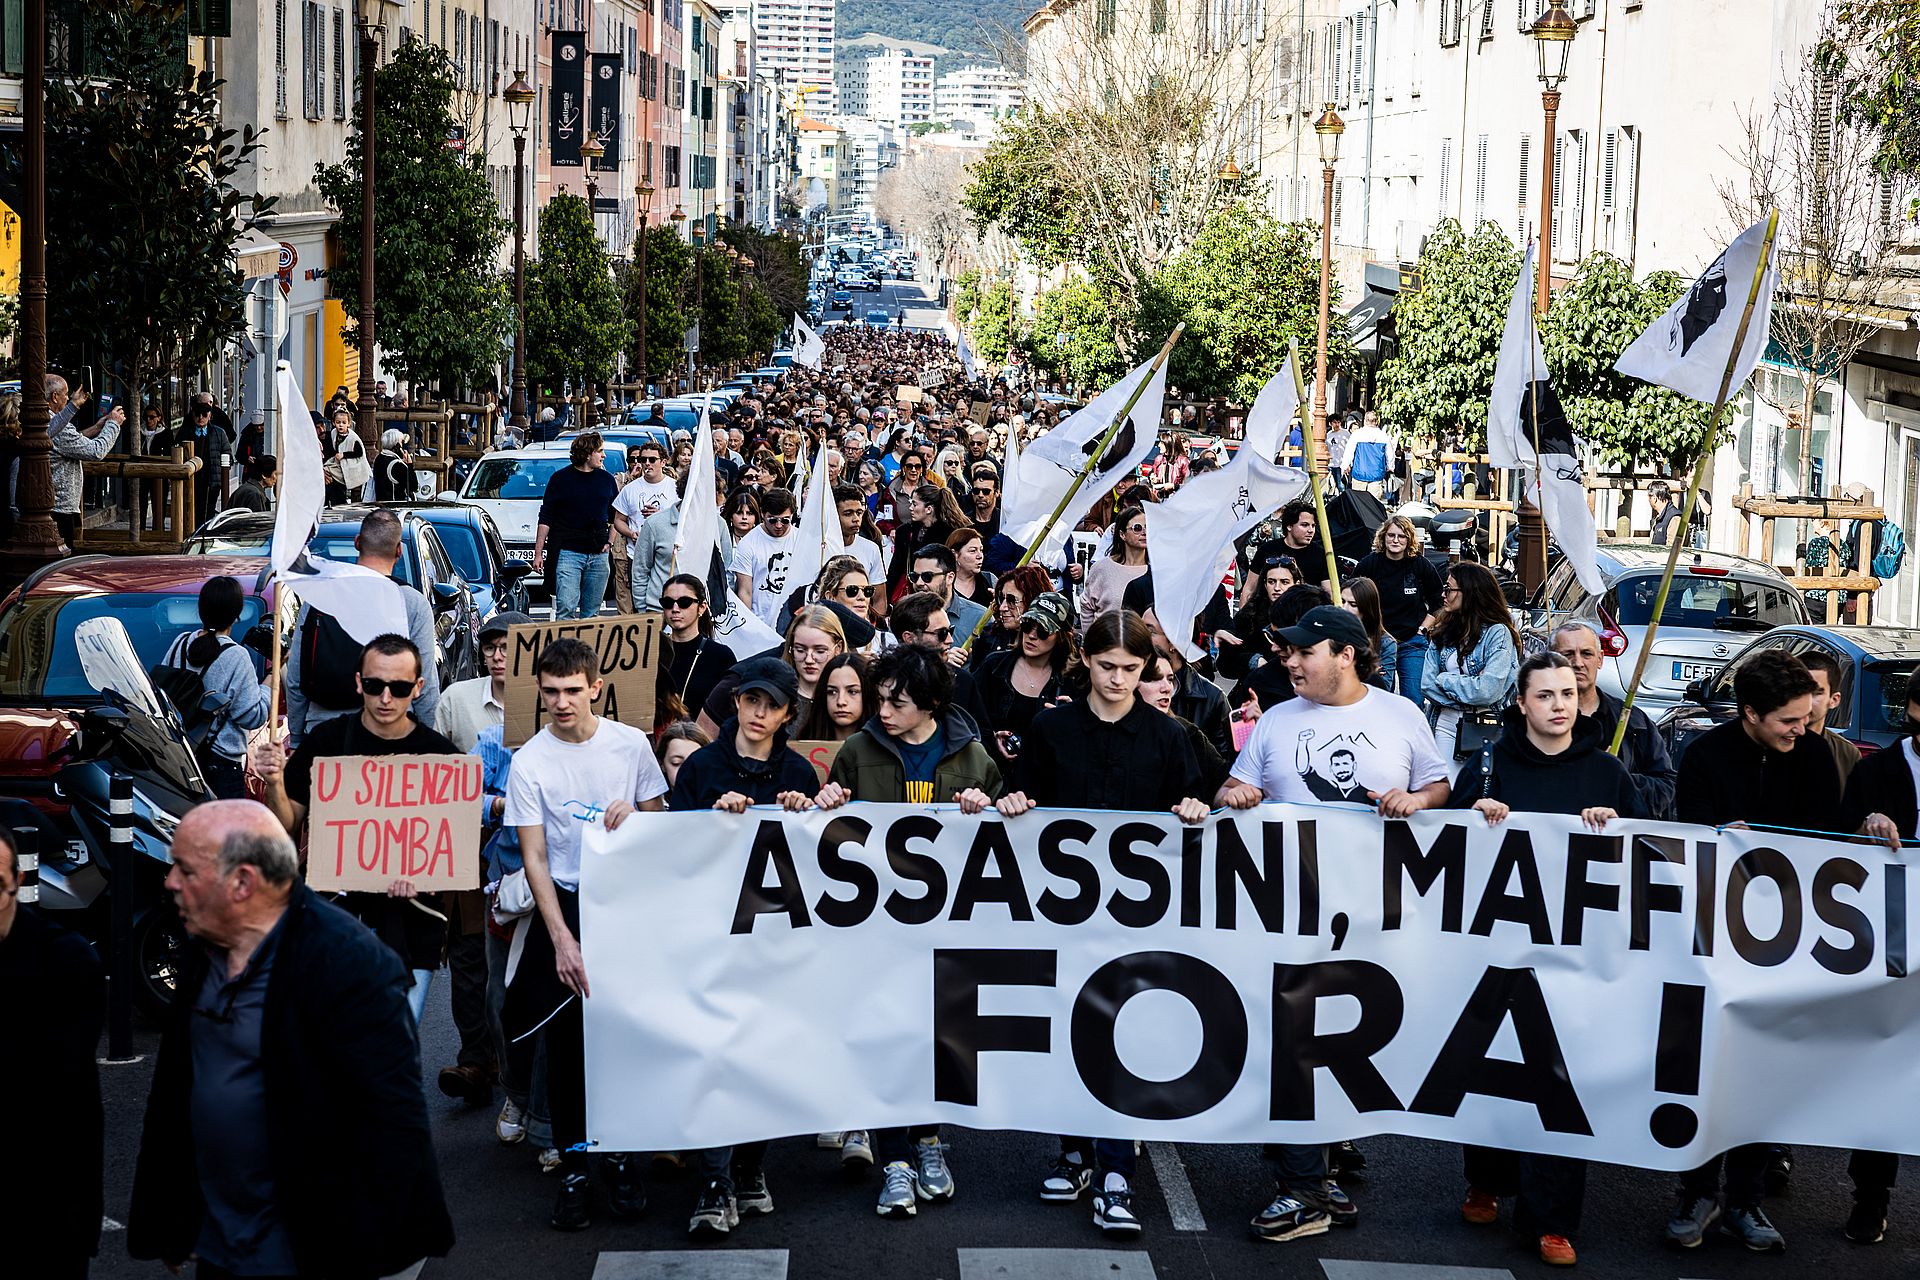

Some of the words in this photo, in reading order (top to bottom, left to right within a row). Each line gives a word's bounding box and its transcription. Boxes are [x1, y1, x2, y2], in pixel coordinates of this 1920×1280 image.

[920, 370, 942, 379] MAFIA
[922, 376, 944, 387] KILLER
[317, 762, 342, 802] U
[354, 757, 481, 808] SILENZIU
[326, 817, 454, 878] TOMBA
[730, 815, 1349, 951] ASSASSINI,
[1382, 819, 1907, 978] MAFFIOSI
[933, 948, 1594, 1137] FORA
[1650, 981, 1705, 1148] !
